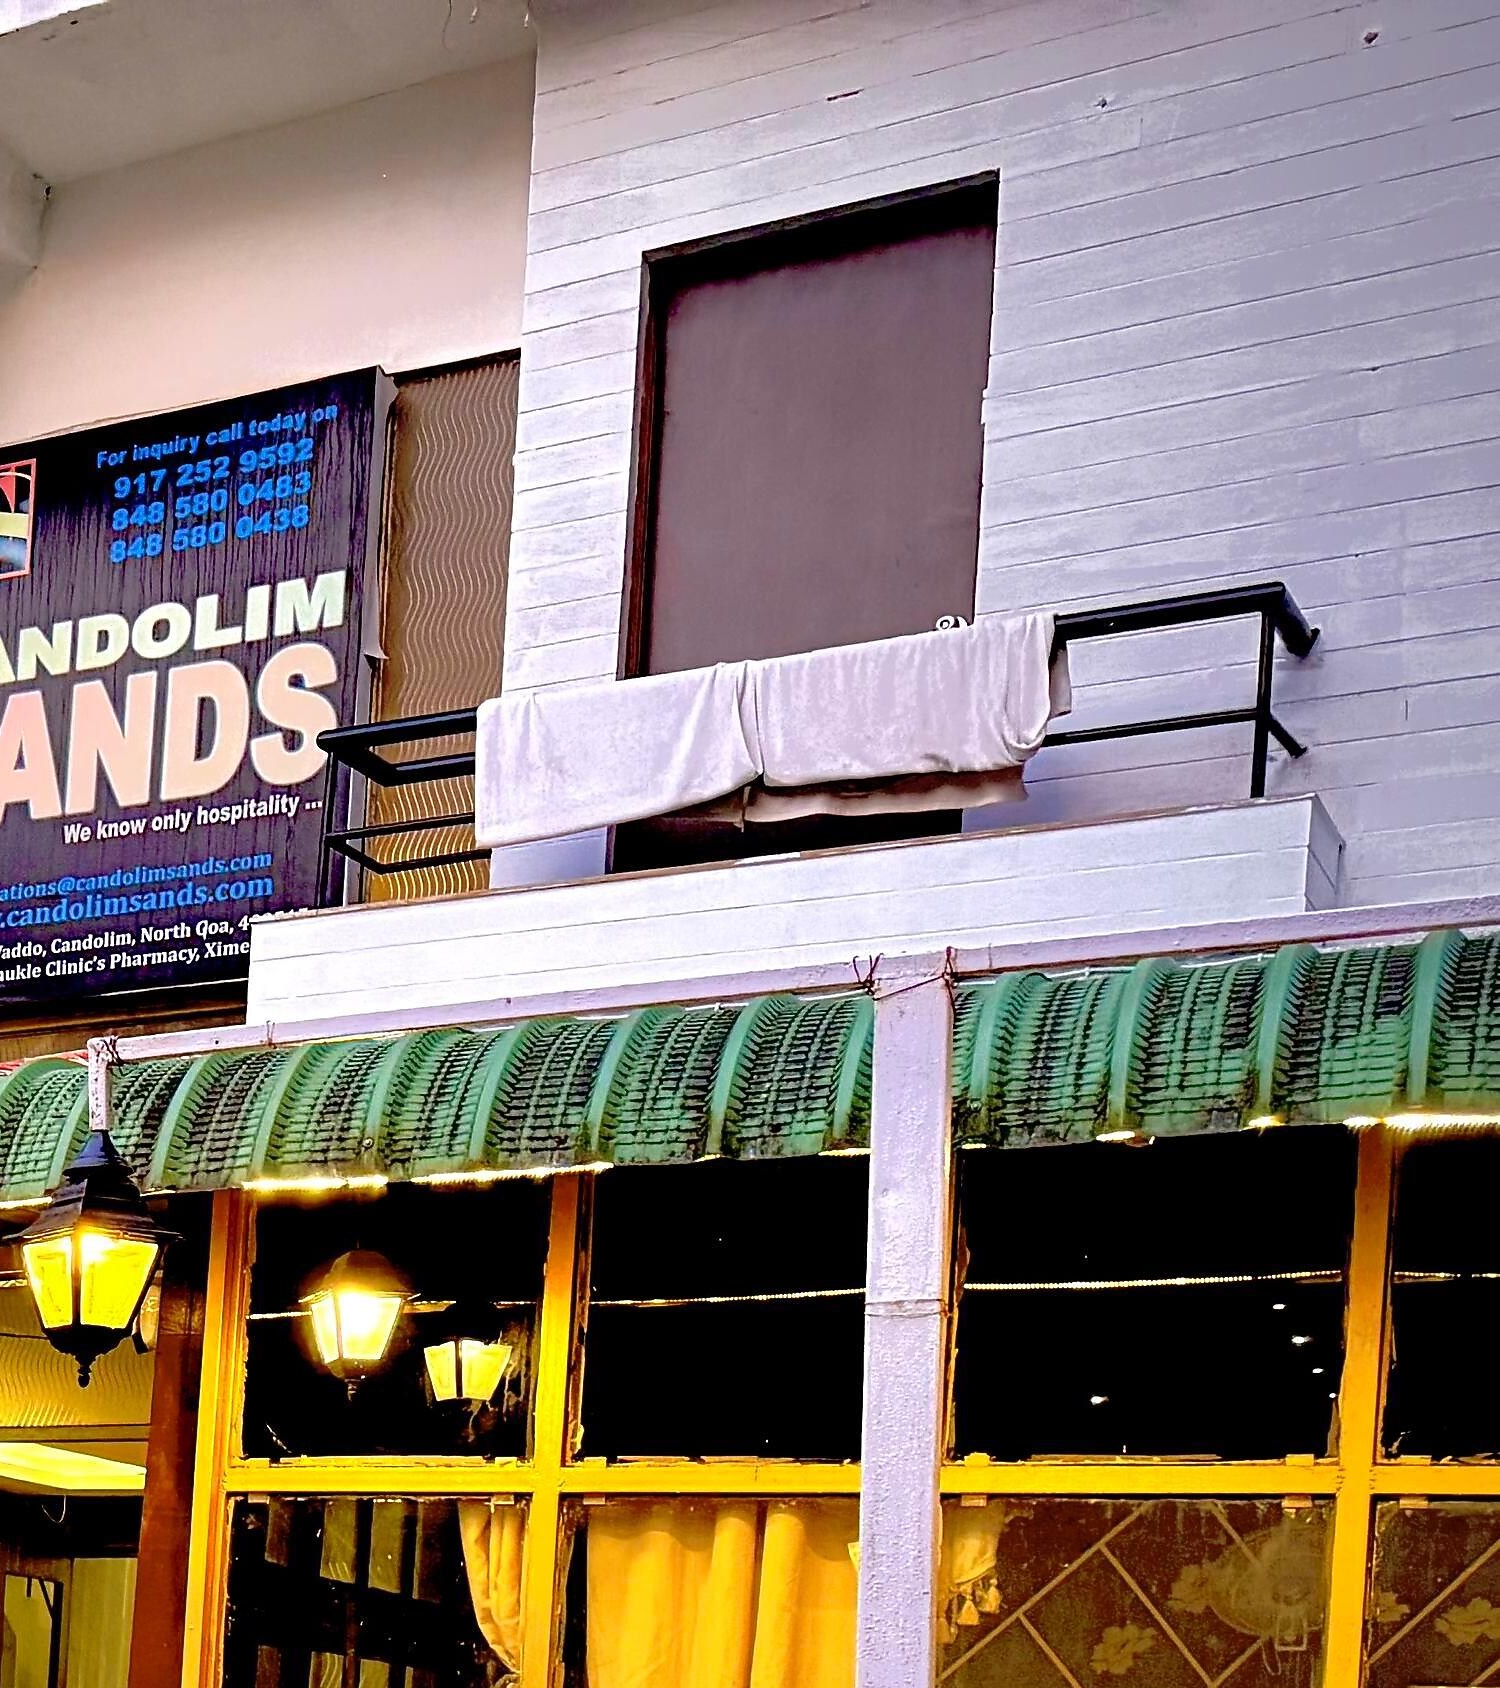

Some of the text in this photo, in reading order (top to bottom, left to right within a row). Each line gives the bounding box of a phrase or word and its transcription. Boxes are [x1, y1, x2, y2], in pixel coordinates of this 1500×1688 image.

[97, 404, 338, 468] For inquiry call today on
[114, 437, 314, 498] 917 252 9592
[112, 471, 311, 531] 848 580 0483
[110, 533, 163, 563] 848
[173, 521, 226, 551] 580
[63, 821, 92, 844] We
[96, 818, 146, 840] know
[151, 810, 192, 832] only
[196, 794, 300, 825] hospitality
[45, 955, 106, 977] Clinic's
[110, 946, 200, 970] Pharmacy,
[50, 931, 136, 954] Candolim,
[140, 924, 191, 943] North
